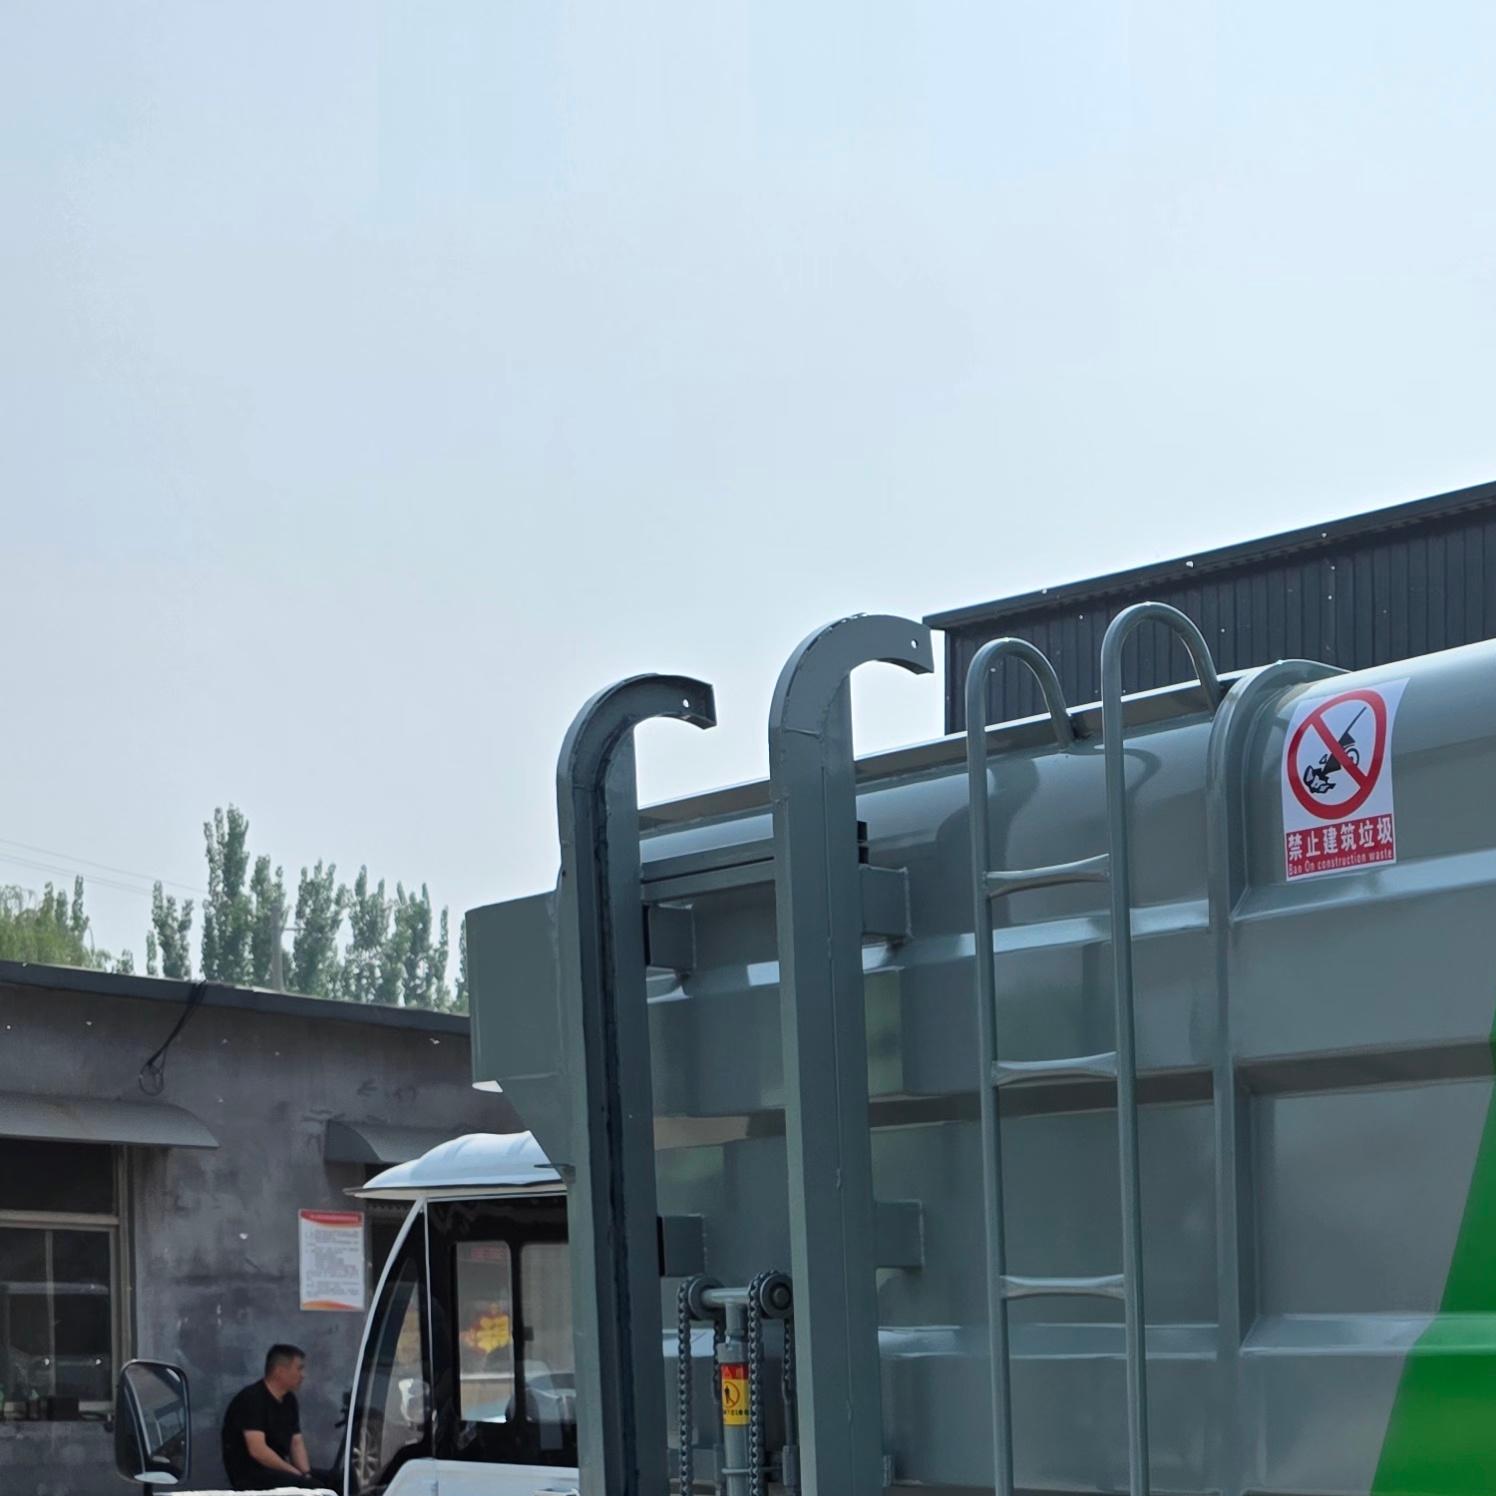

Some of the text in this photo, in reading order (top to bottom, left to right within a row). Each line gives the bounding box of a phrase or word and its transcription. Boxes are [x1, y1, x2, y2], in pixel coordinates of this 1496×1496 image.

[1288, 817, 1393, 861] 禁止建筑垃圾
[1289, 848, 1393, 876] Ban On construction waste
